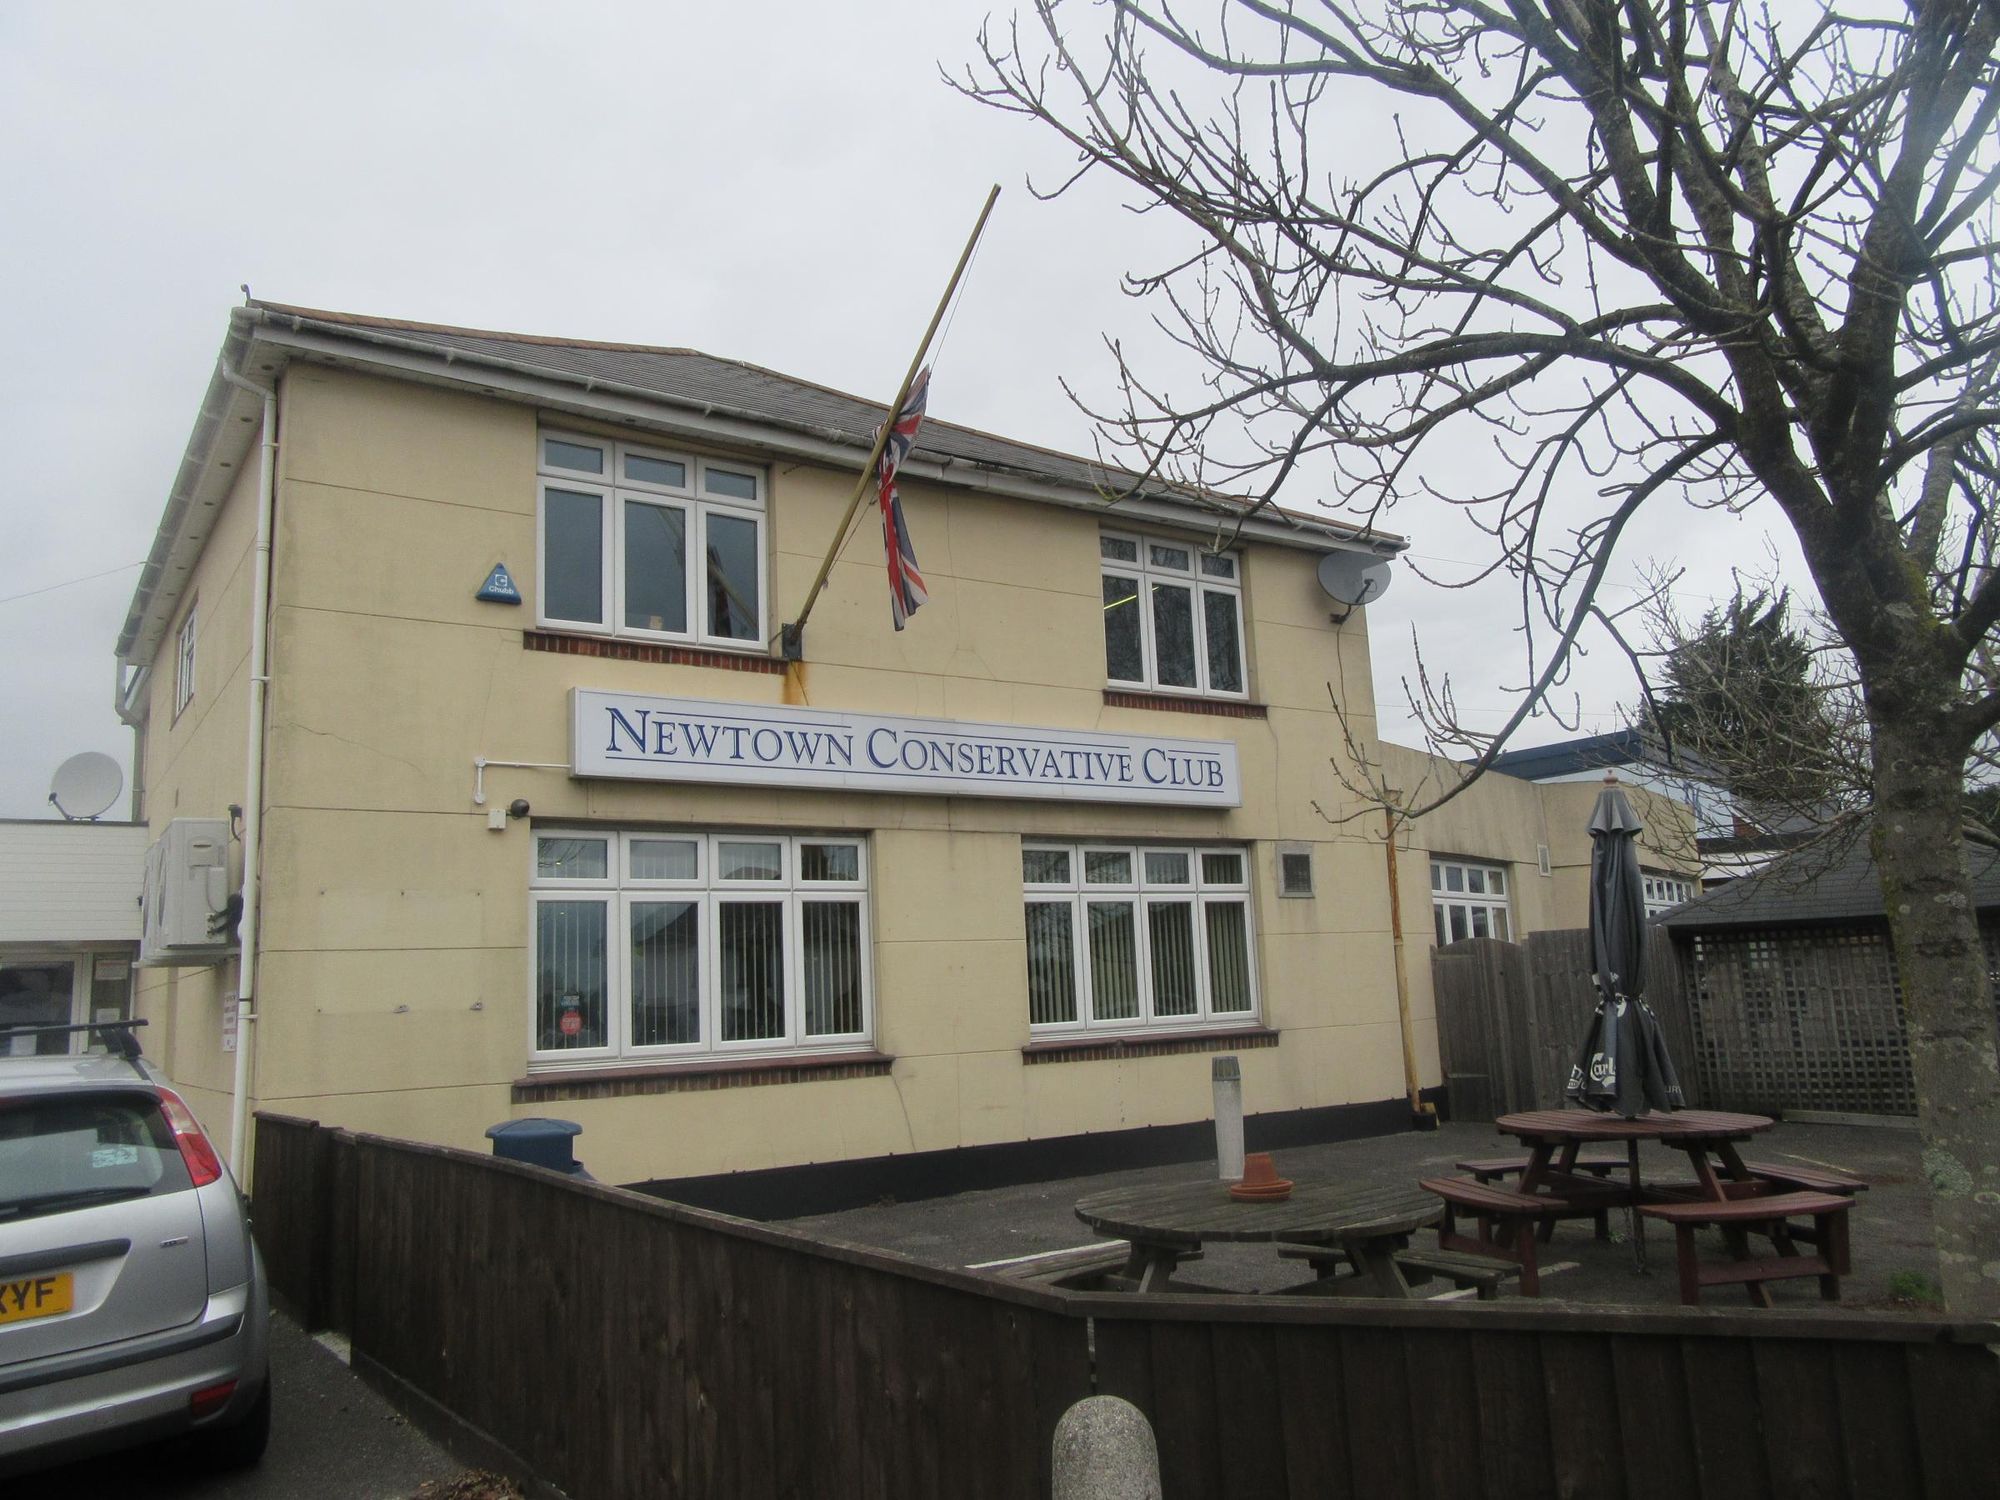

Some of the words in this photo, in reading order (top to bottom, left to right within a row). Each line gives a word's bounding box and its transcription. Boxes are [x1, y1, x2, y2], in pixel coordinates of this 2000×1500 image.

[489, 585, 514, 595] Chubb
[605, 707, 854, 767] NEWTOWN
[866, 728, 1135, 783] CONSERVATIVE
[1142, 747, 1224, 788] CLUB
